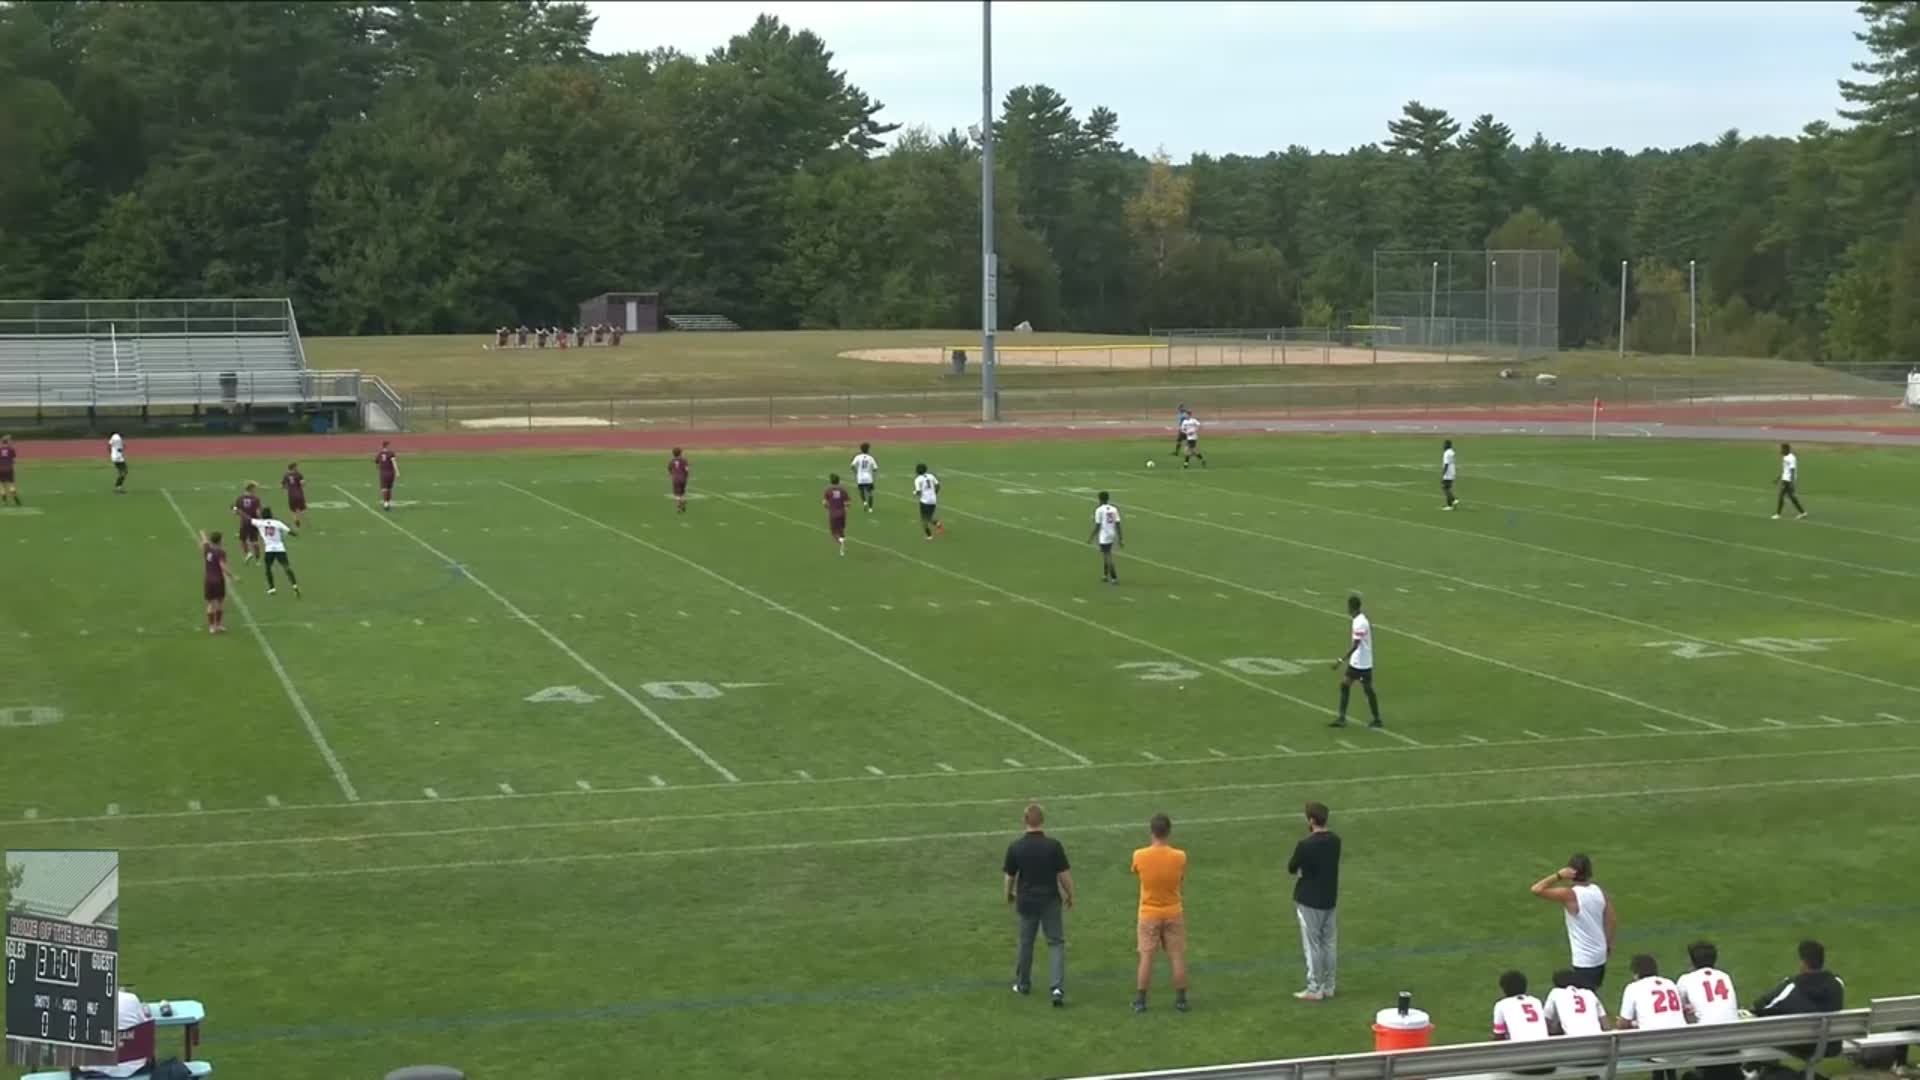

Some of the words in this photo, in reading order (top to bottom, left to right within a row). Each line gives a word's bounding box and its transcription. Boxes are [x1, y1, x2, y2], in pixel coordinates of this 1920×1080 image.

[1652, 989, 1681, 1014] 28
[1703, 979, 1729, 1003] 14
[1521, 1004, 1539, 1022] 5
[1573, 995, 1587, 1014] 3
